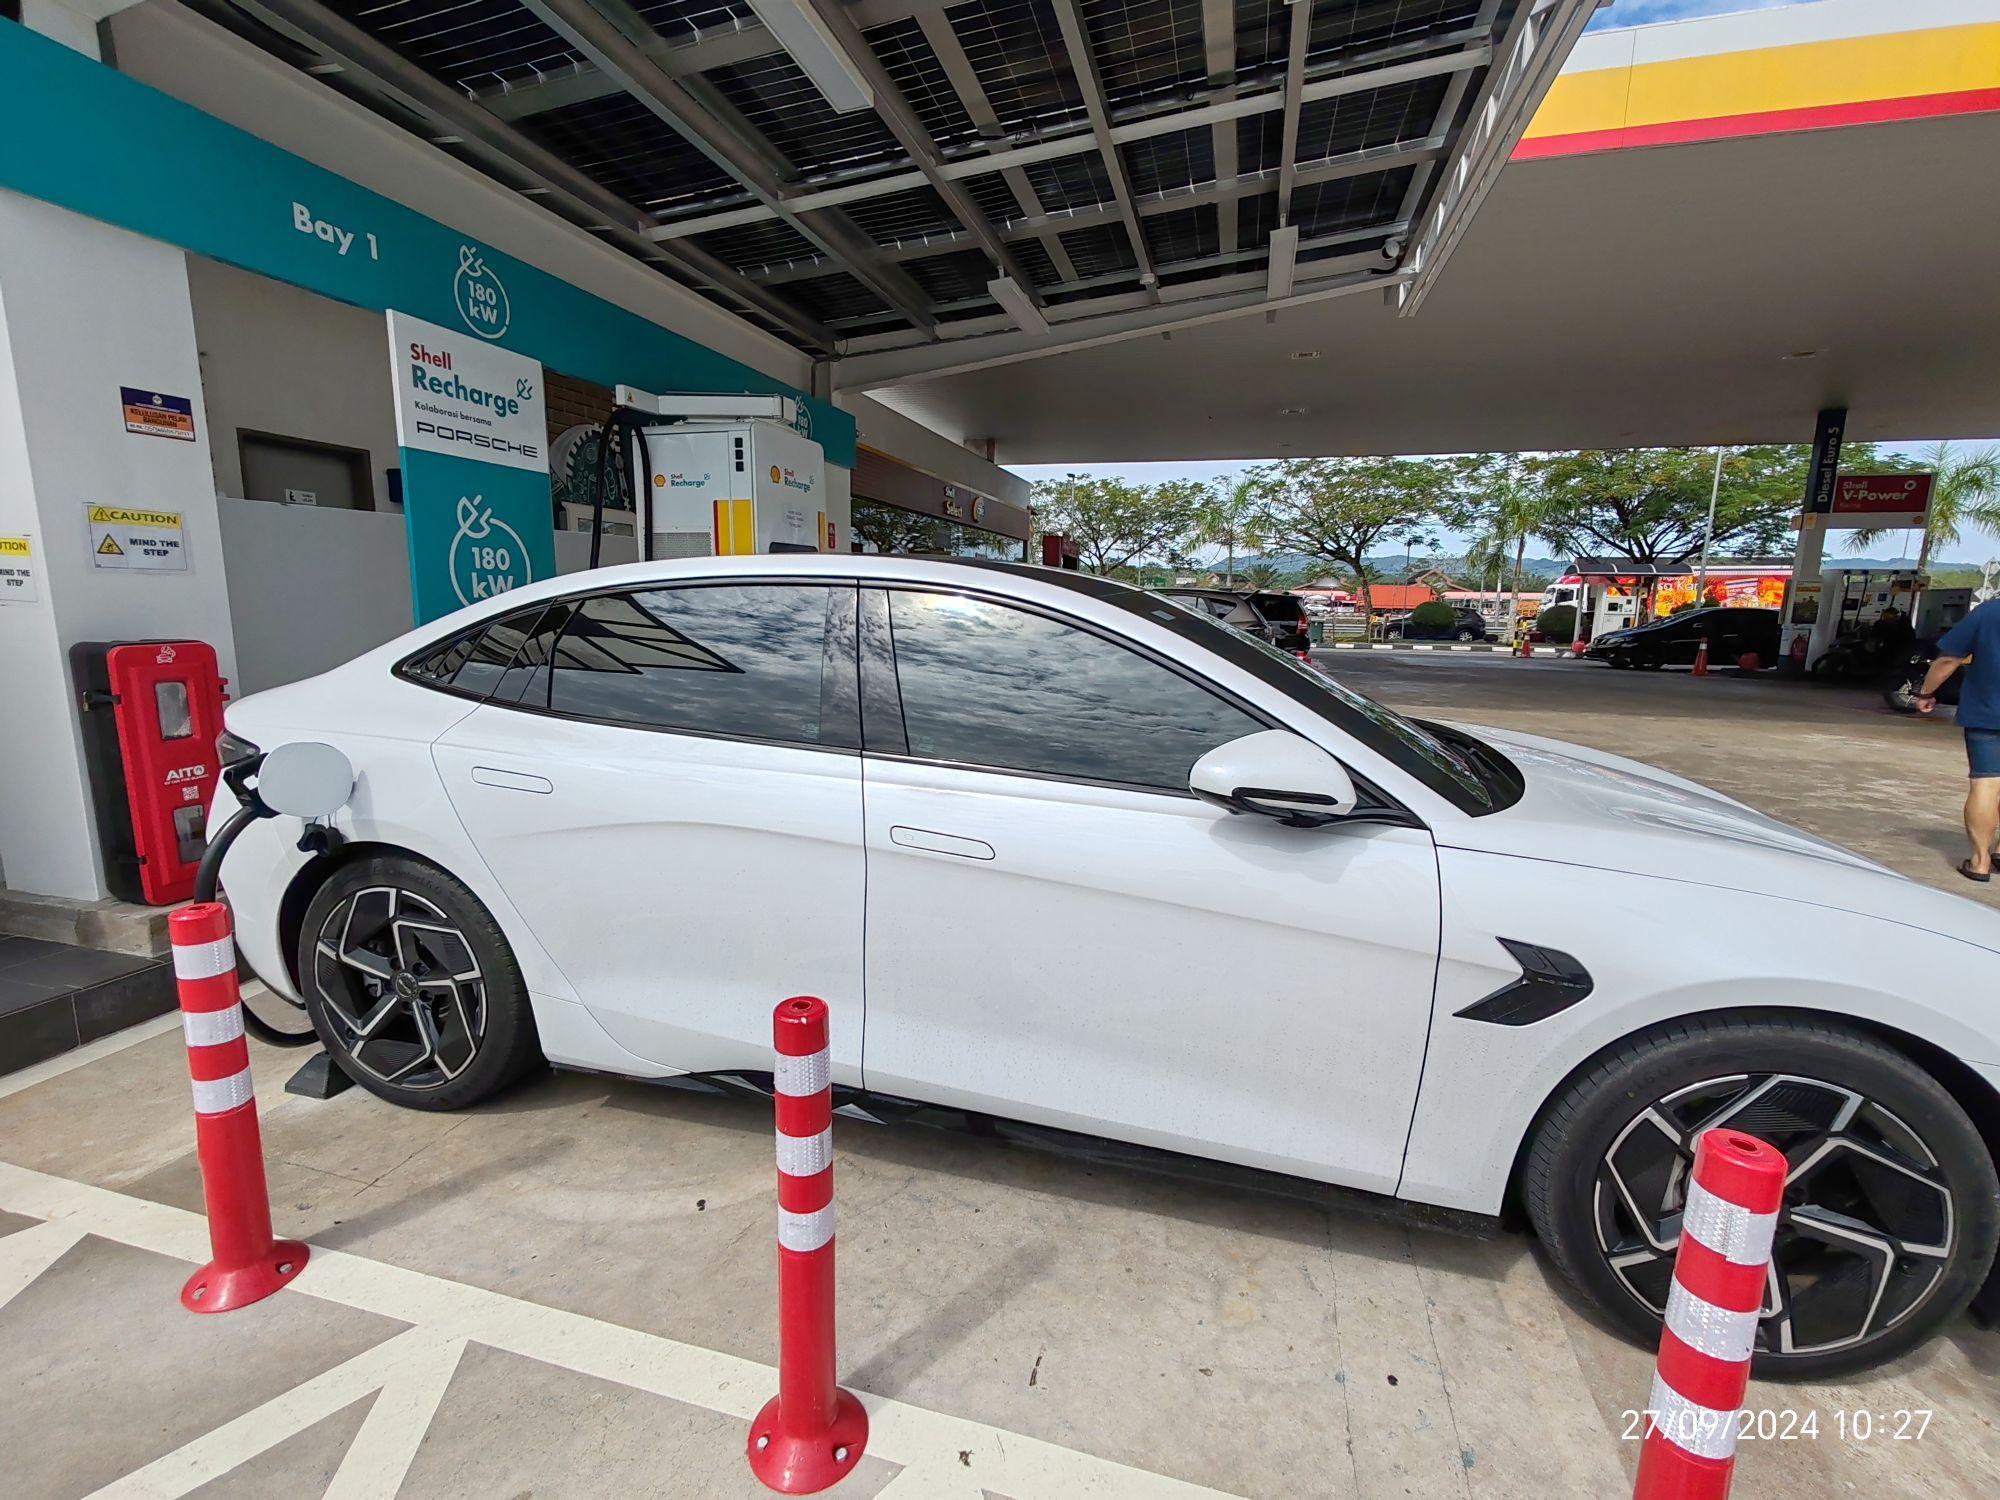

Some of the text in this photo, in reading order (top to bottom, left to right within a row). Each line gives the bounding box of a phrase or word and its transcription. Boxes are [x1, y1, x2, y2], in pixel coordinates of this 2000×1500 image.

[292, 201, 379, 261] Bay 1
[467, 280, 497, 306] 180
[468, 298, 498, 325] kW
[410, 342, 452, 371] Shell
[411, 363, 519, 418] Recharge
[414, 400, 492, 427] Kolaborasi bersama
[416, 421, 538, 459] PORSCHE
[784, 467, 795, 478] Shell
[1817, 426, 1840, 503] Diesel Euro 5
[670, 472, 683, 480] Shell
[670, 479, 705, 489] Recharge
[784, 475, 811, 494] Recharge
[1842, 481, 1868, 490] Shell
[1842, 489, 1909, 501] V-Power
[109, 511, 178, 525] CAUTION
[129, 538, 180, 548] MIND THE
[143, 548, 169, 557] STEP
[471, 547, 510, 571] 180
[16, 569, 31, 577] THE
[6, 578, 24, 587] STEP
[471, 572, 514, 599] kW
[166, 765, 205, 781] AITO
